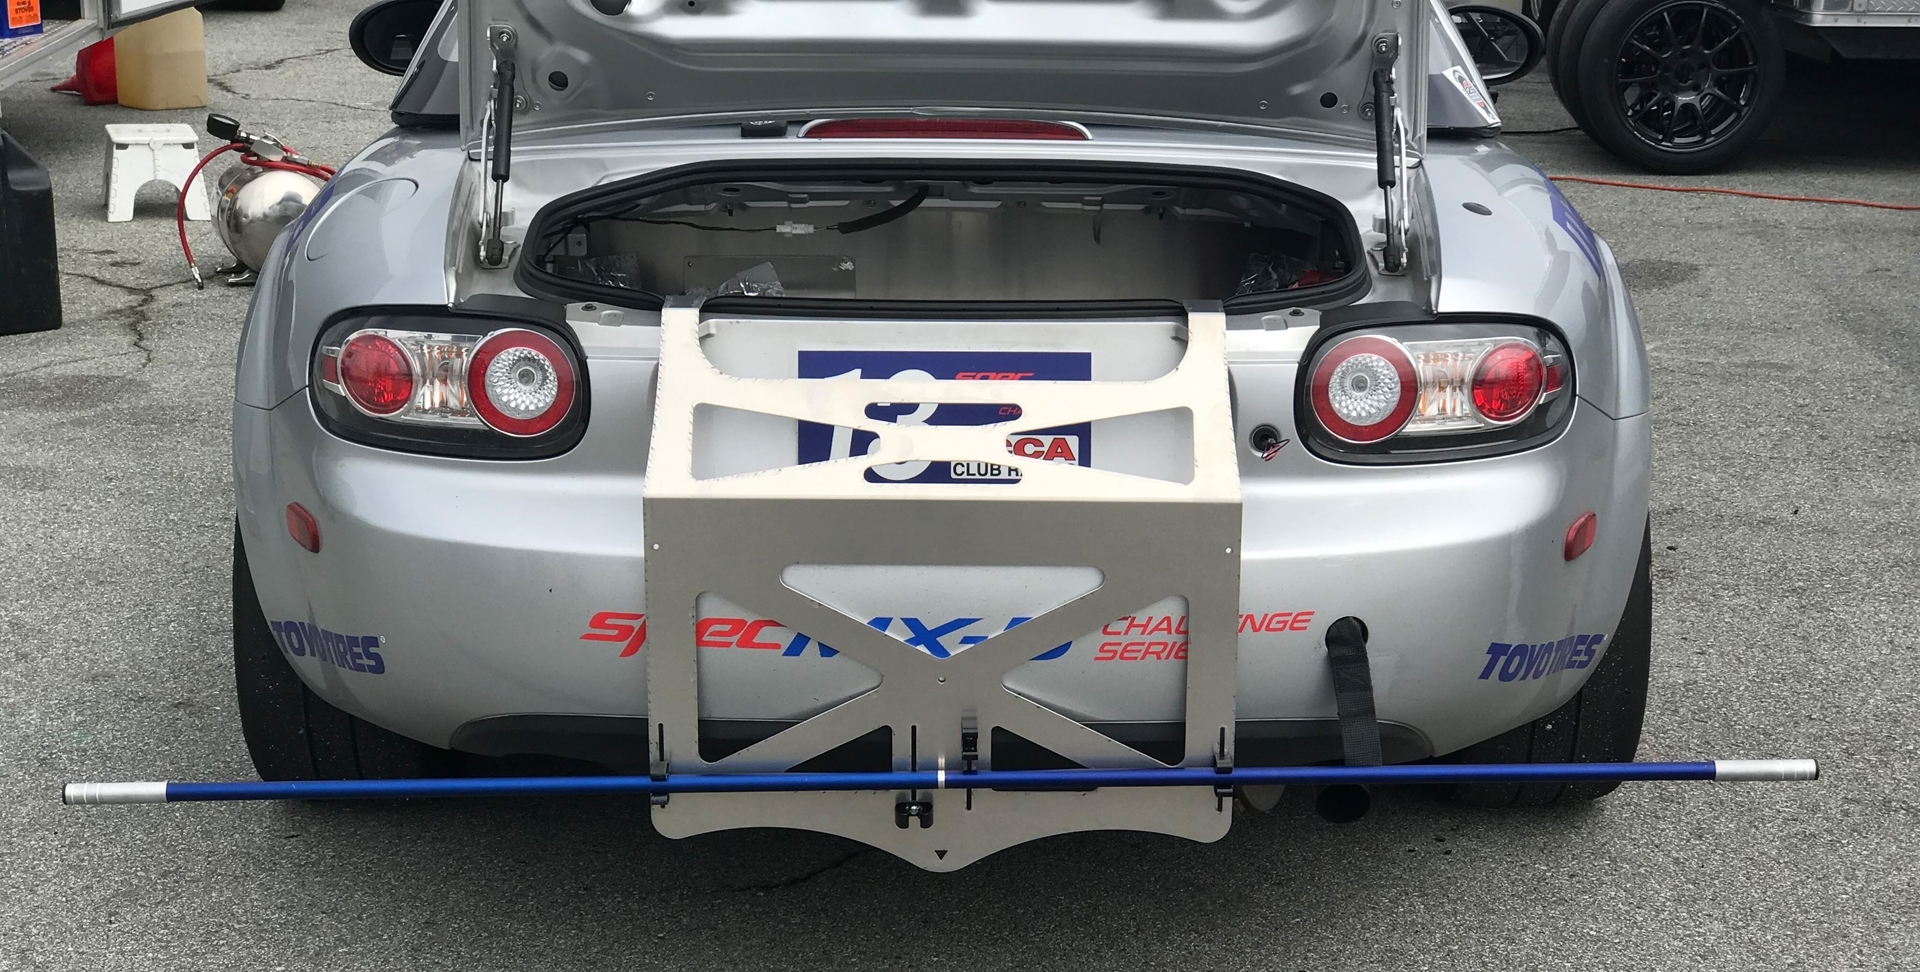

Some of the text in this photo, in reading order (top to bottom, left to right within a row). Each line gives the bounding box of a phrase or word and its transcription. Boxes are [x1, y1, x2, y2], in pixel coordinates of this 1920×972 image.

[1006, 437, 1076, 461] CA
[953, 462, 1001, 477] CLUB
[1101, 610, 1315, 636] CHALNGE
[1093, 641, 1189, 661] SERIE
